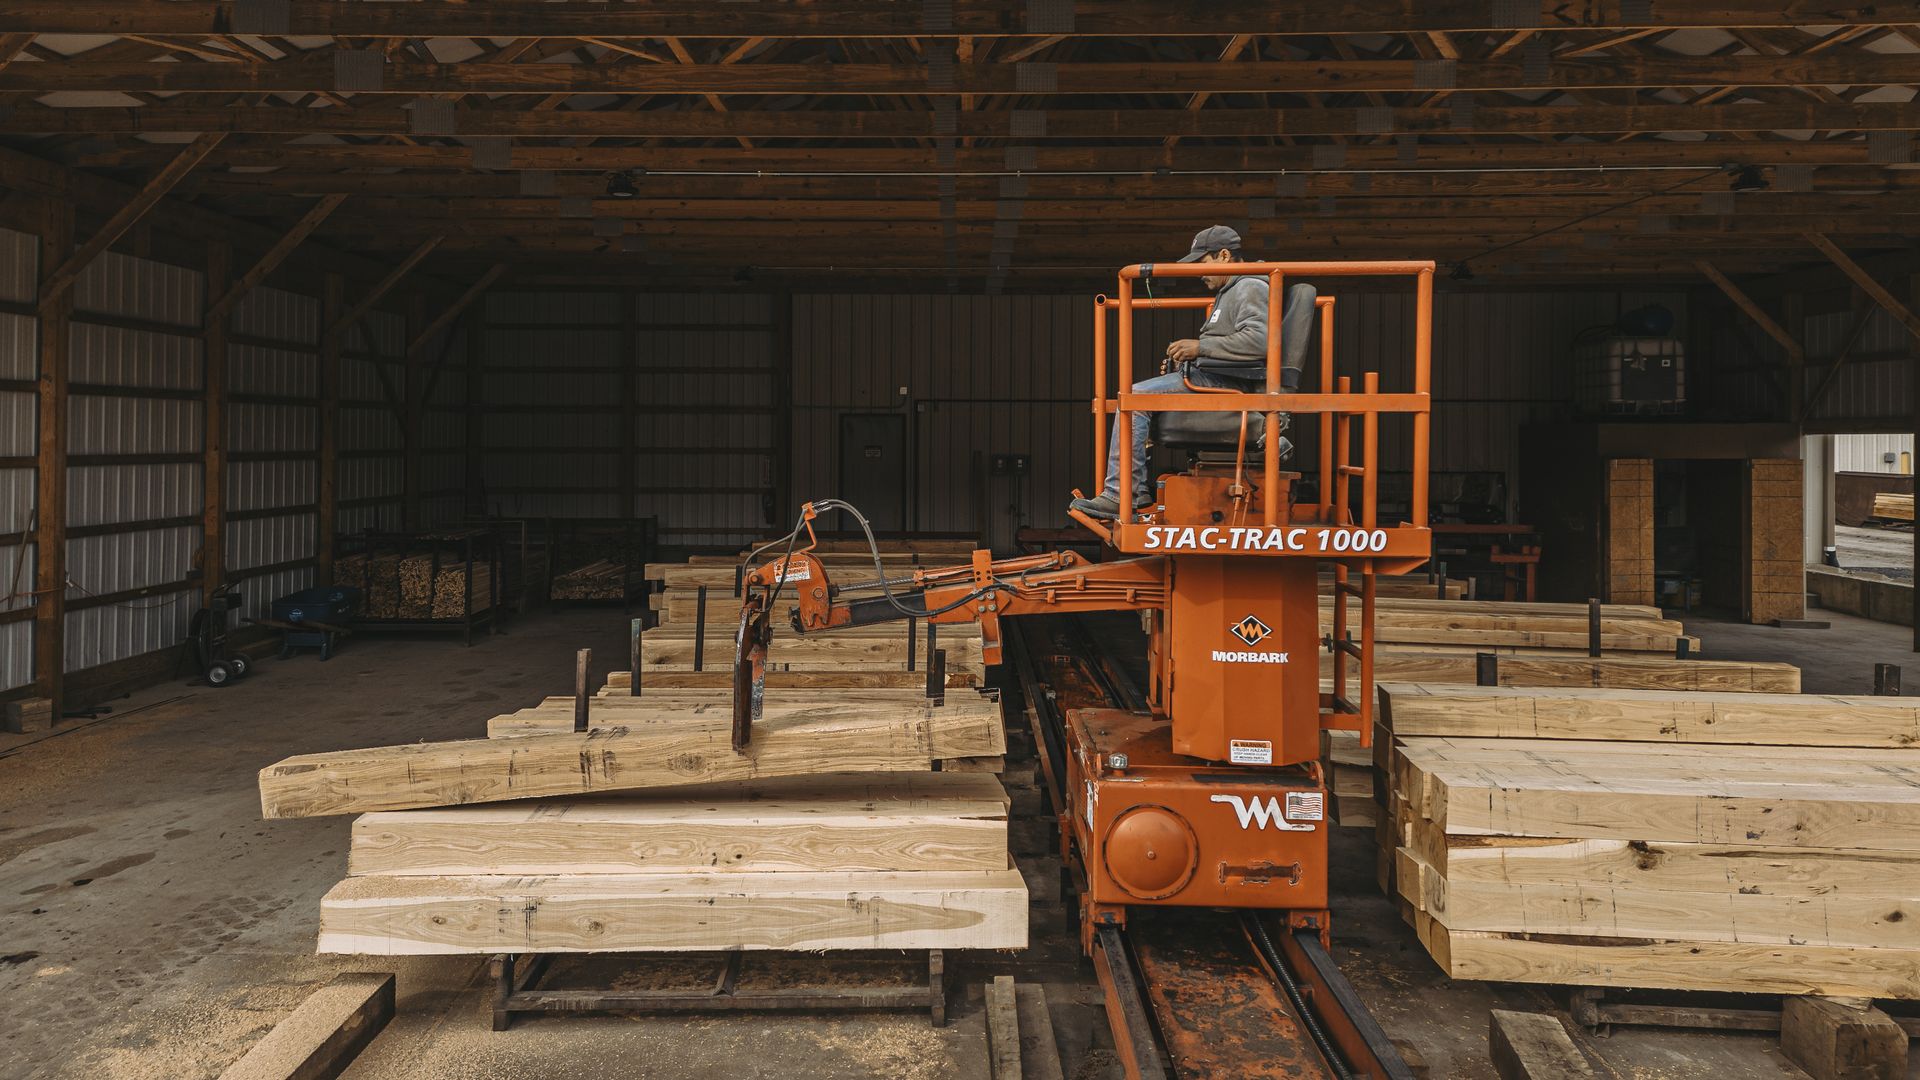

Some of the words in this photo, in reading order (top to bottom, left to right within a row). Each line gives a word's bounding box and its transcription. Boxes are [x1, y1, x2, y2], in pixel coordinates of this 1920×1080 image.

[1144, 527, 1308, 550] STAC-TRAC
[1317, 529, 1388, 552] 1000
[1212, 650, 1289, 663] MORBARK
